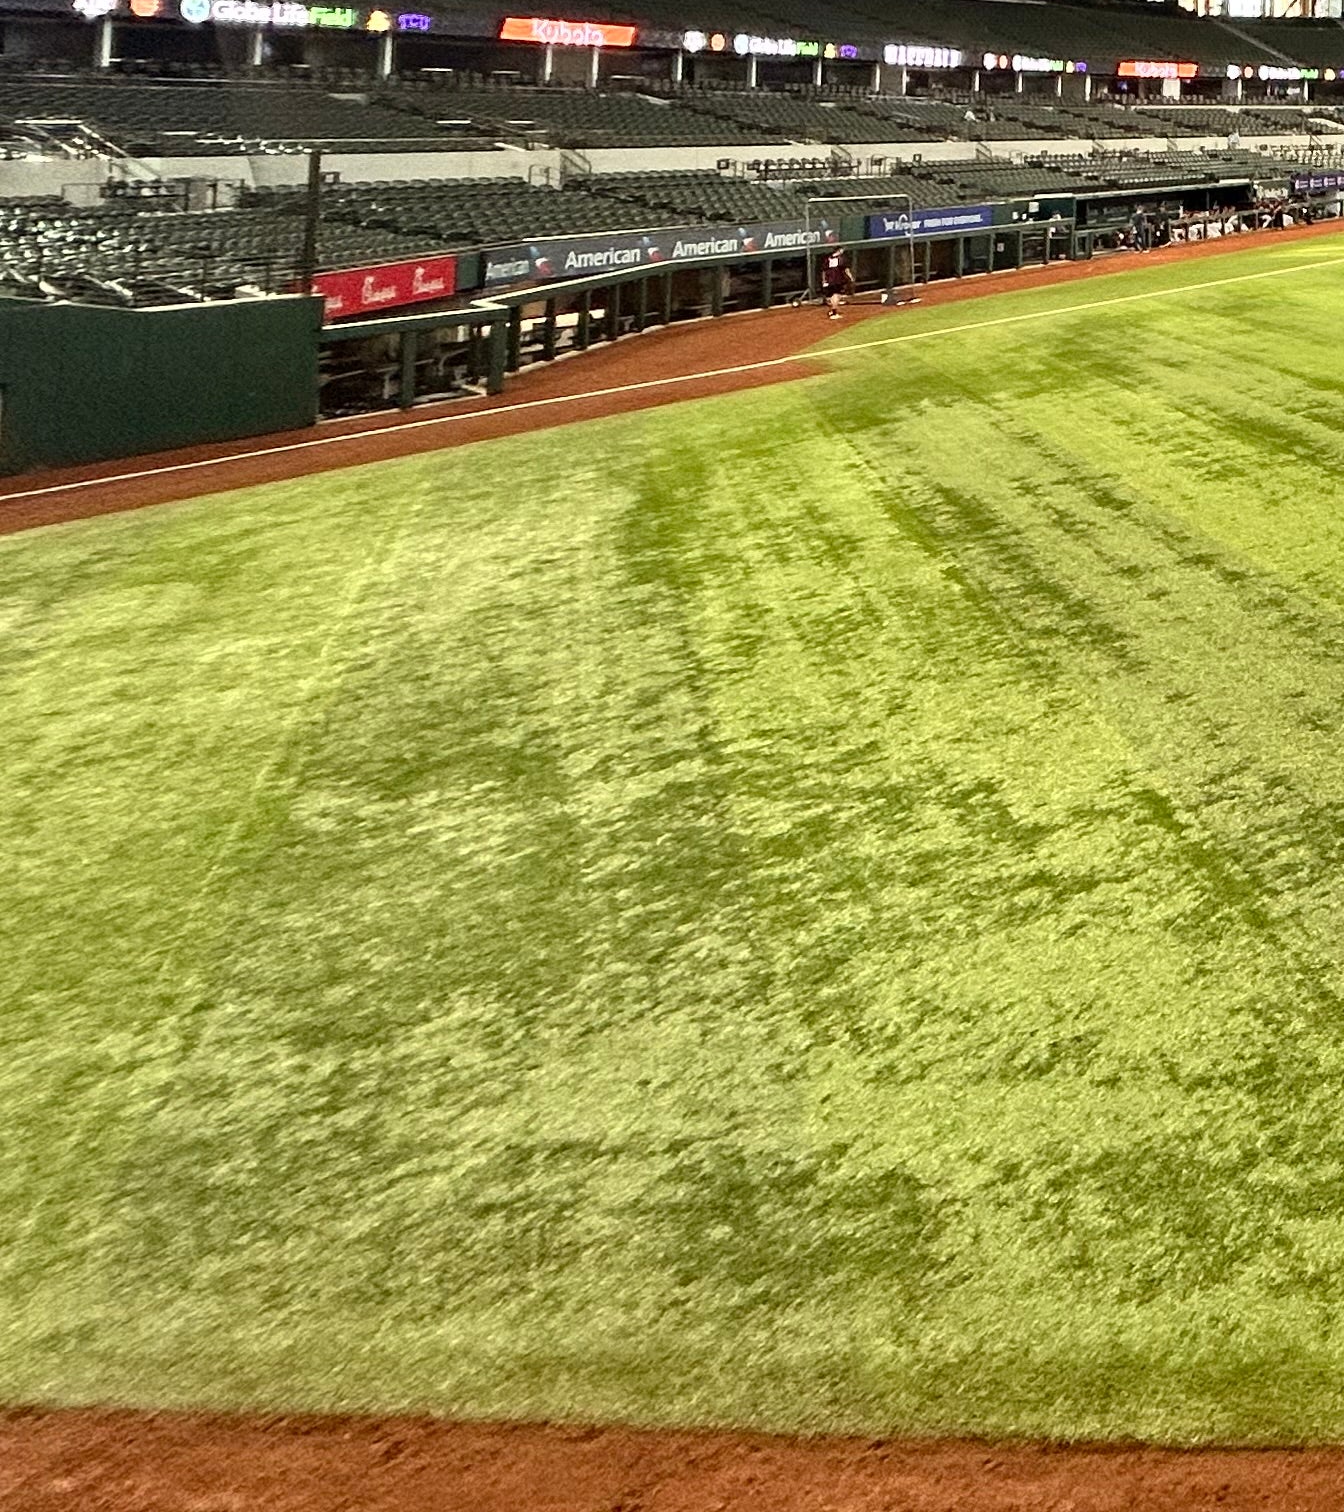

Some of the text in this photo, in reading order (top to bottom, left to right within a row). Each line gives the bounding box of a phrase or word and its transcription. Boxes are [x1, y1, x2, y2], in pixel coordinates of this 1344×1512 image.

[212, 0, 357, 28] Globe Life Field
[398, 13, 431, 31] TCU
[531, 18, 604, 46] Kubota
[672, 237, 738, 258] American
[764, 229, 821, 248] American
[564, 247, 641, 270] American
